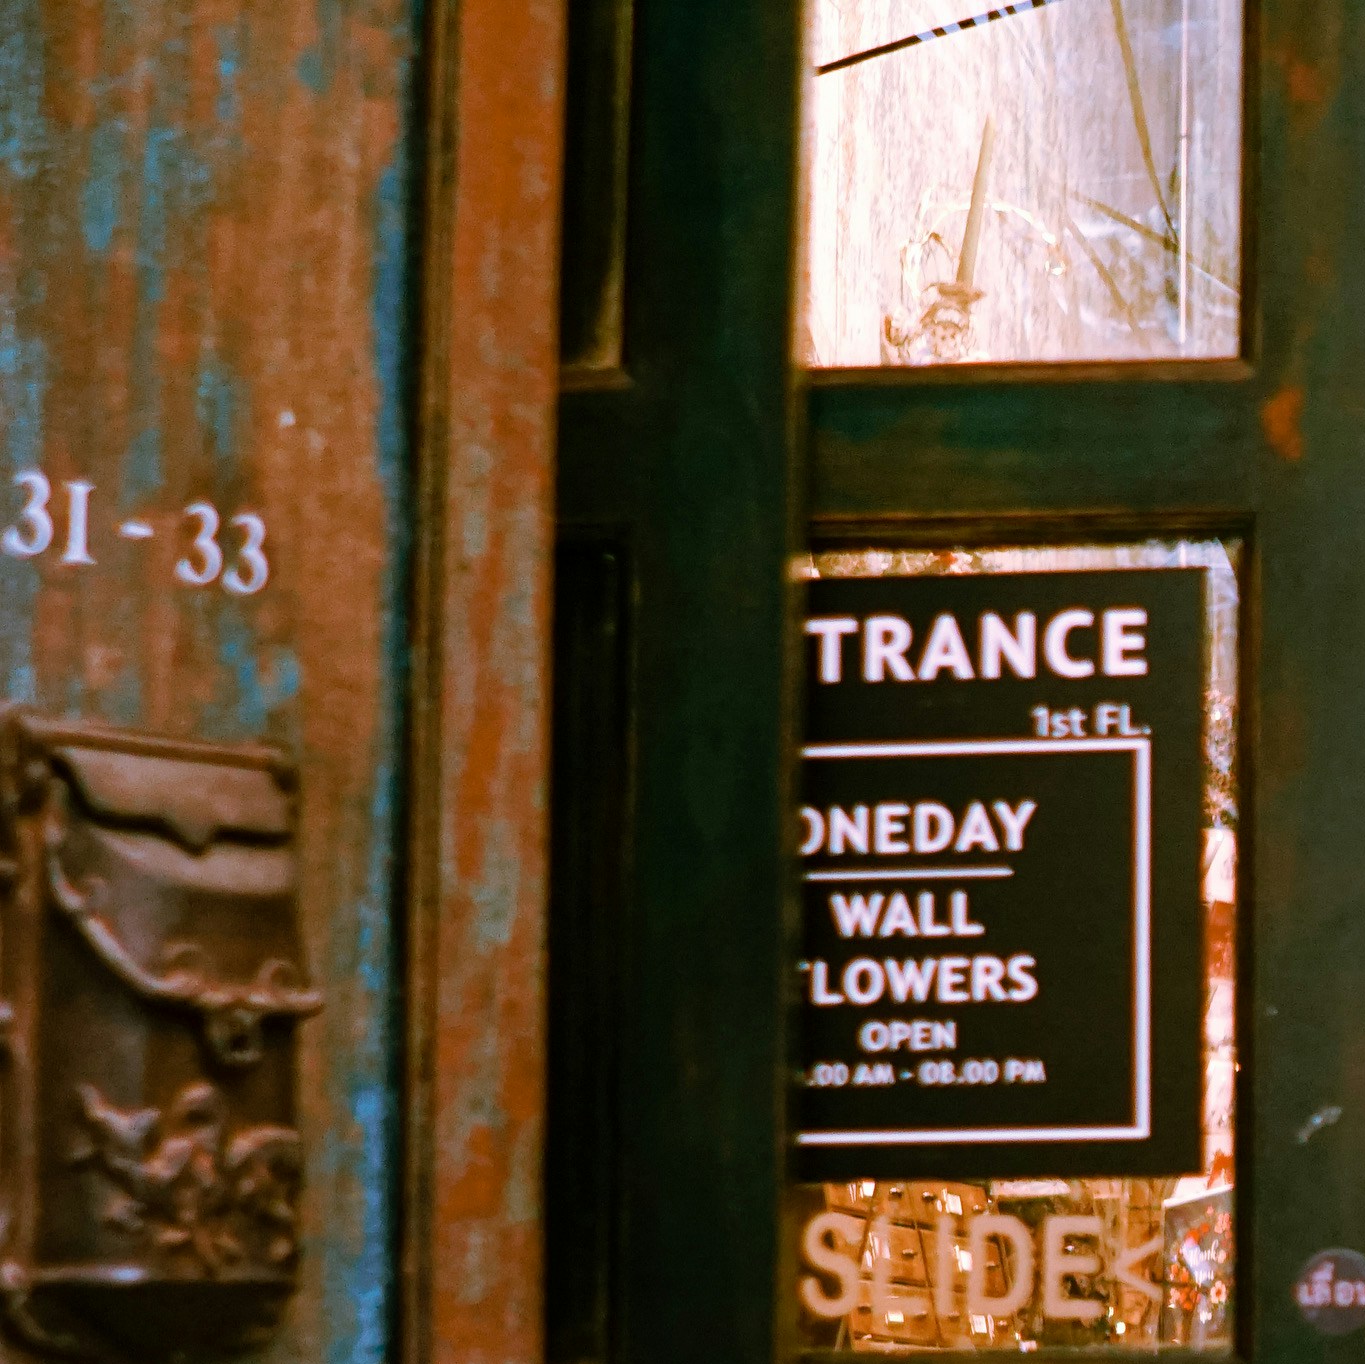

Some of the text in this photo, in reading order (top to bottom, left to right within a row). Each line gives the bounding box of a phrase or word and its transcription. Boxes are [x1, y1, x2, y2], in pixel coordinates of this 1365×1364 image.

[1031, 702, 1152, 738] 1st FL.
[830, 889, 985, 938] WALL
[798, 953, 1040, 1005] LOWERS
[858, 1018, 958, 1053] OPEN
[801, 1060, 850, 1088] .00
[852, 1061, 897, 1086] AM
[915, 1058, 1001, 1085] 08.00
[1003, 1057, 1047, 1084] PM
